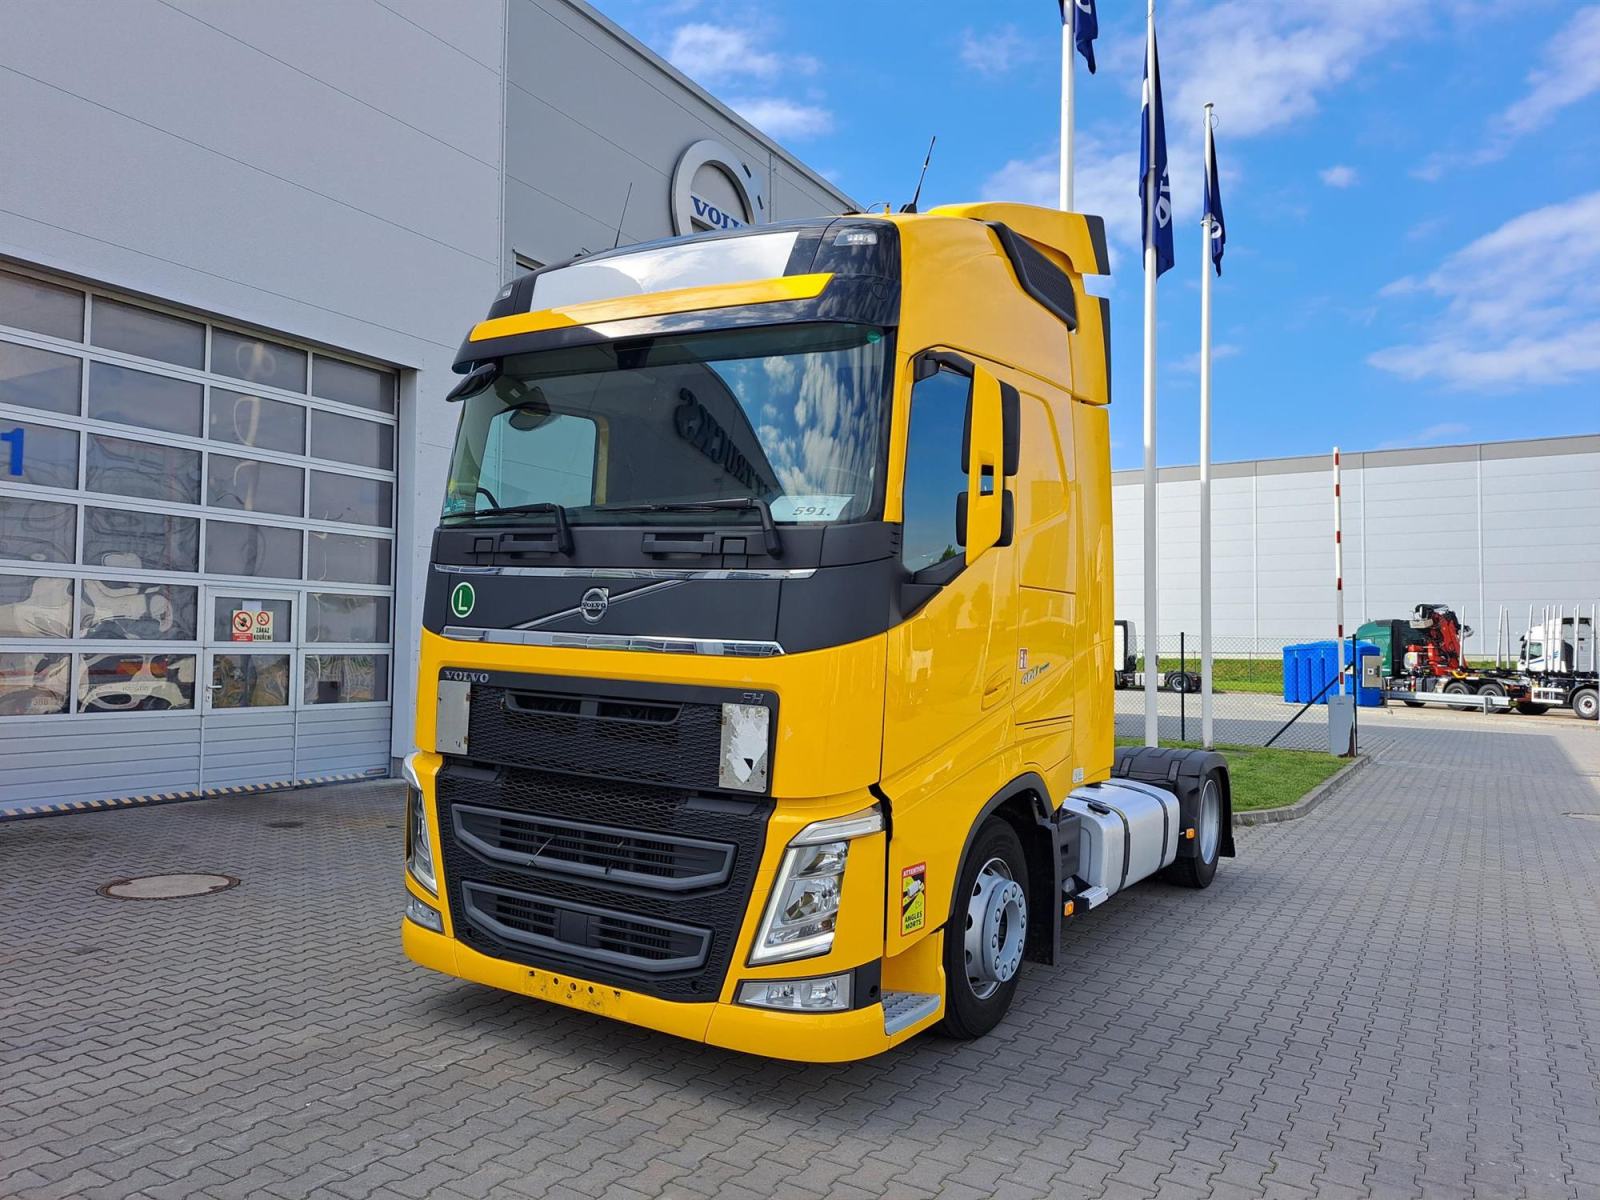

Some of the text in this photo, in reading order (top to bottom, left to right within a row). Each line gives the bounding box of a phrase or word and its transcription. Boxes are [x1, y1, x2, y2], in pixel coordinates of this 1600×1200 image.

[0, 427, 24, 476] 1
[458, 590, 468, 611] L
[582, 601, 606, 609] VOLVO
[445, 671, 489, 683] VOLVO
[905, 911, 922, 921] ANGLES
[905, 919, 921, 929] MORTS
